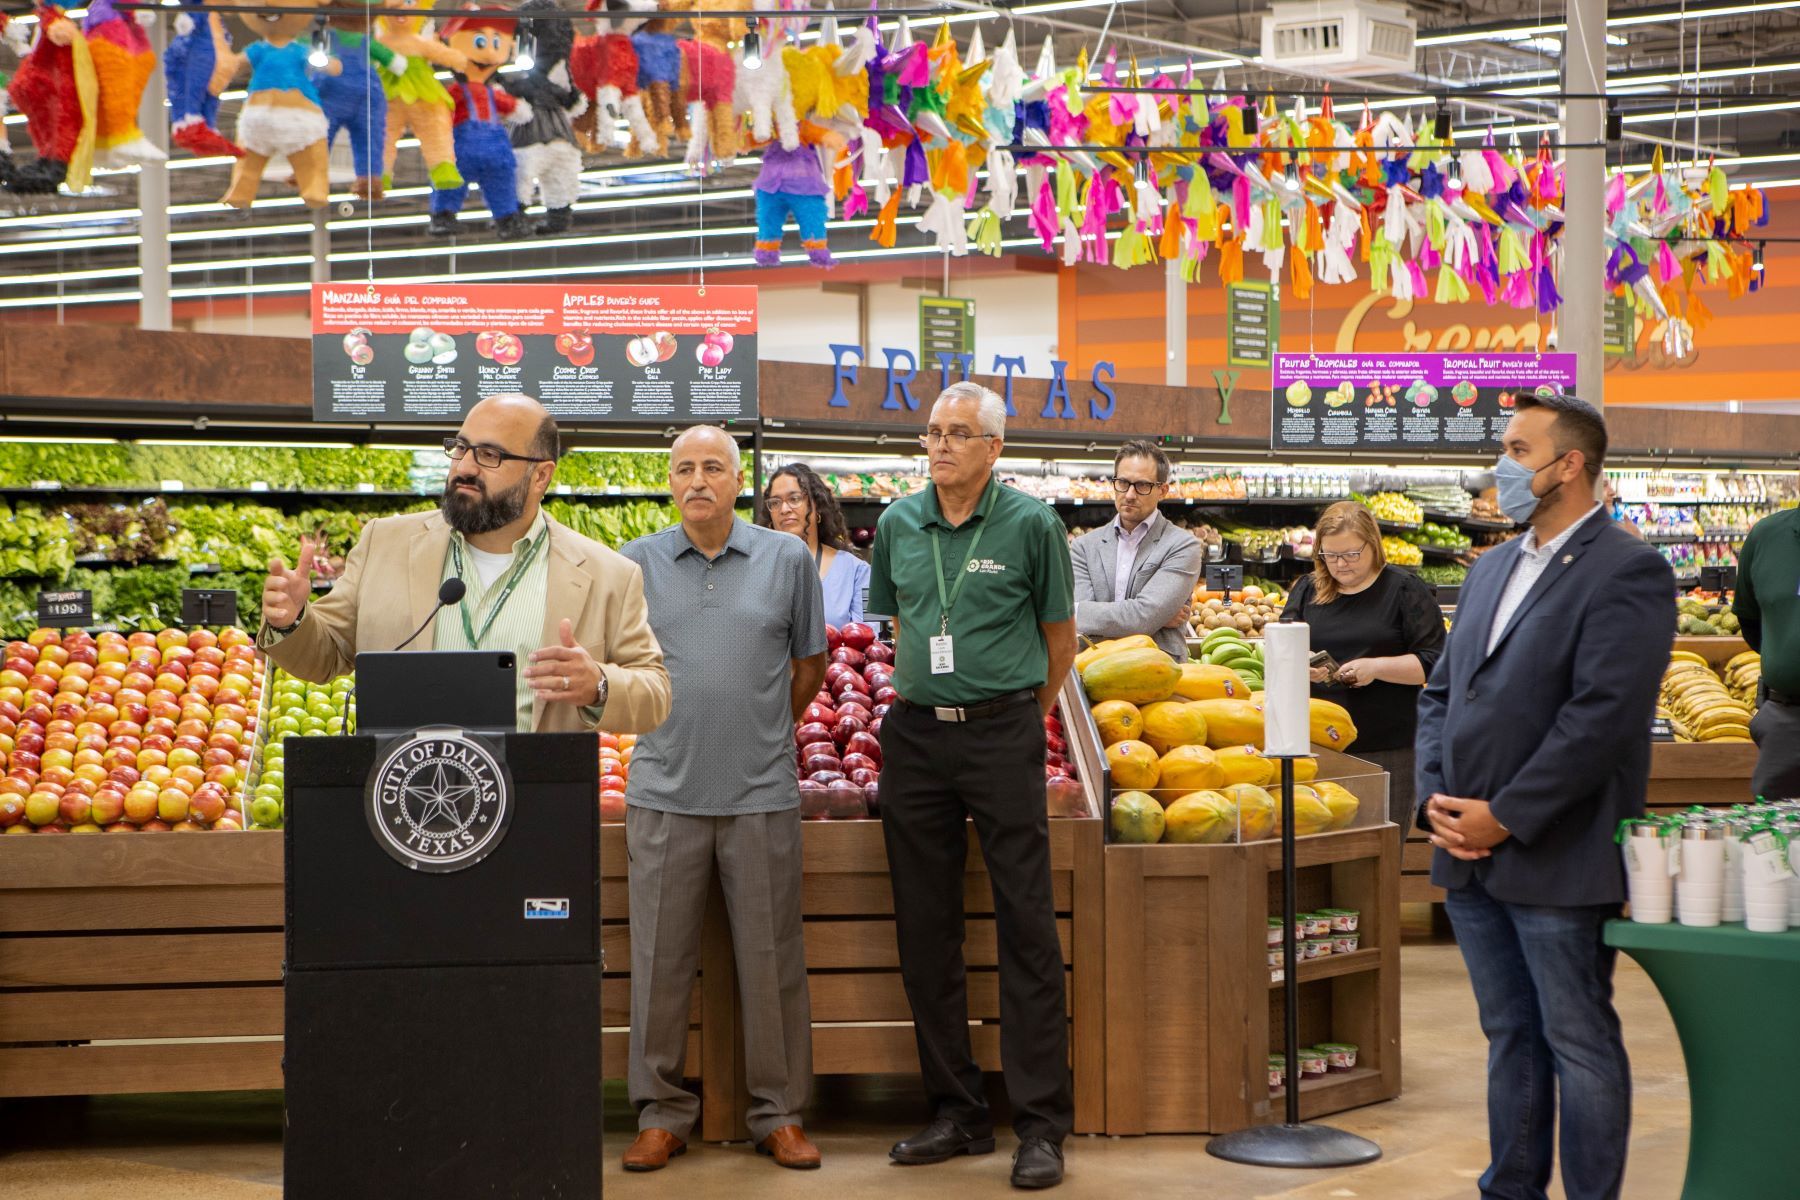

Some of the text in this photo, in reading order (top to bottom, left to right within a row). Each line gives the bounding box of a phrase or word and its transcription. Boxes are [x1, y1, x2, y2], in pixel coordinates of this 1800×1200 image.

[322, 290, 381, 304] MANZANAS
[404, 296, 419, 304] DEL
[422, 296, 468, 304] COMPRADOR
[563, 293, 660, 306] APPLES BUYER'S GUIDE
[1272, 285, 1279, 301] 2
[408, 365, 455, 374] GRANNY SMITH
[1280, 358, 1310, 368] FRUTAS
[1314, 358, 1358, 368] TROPICALES
[1443, 358, 1477, 368] TROPICAL
[1479, 358, 1501, 368] FRUIT
[502, 366, 521, 374] CRISP
[554, 366, 577, 374] COSMIC
[828, 343, 1241, 424] FRUTAS Y
[383, 742, 497, 805] CITY OF DALLAS
[406, 830, 475, 855] TEXAS
